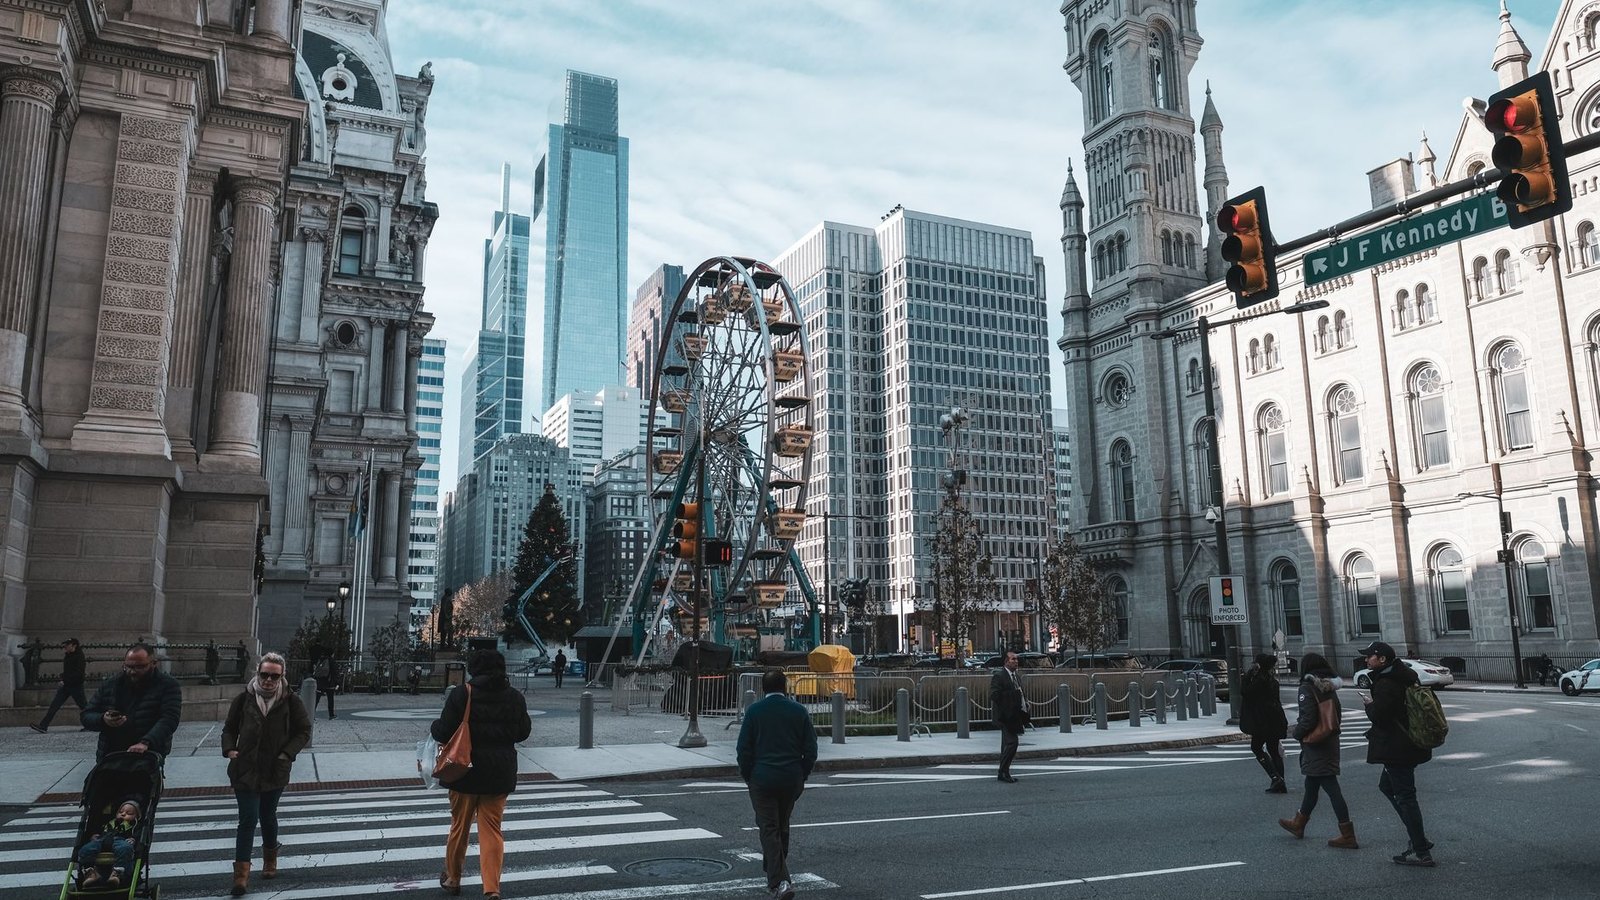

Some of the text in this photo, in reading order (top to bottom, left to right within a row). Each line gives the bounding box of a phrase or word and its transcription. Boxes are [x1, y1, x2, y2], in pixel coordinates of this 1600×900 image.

[1337, 247, 1348, 268] J
[1358, 239, 1370, 261] F
[1381, 207, 1478, 254] Kennedy
